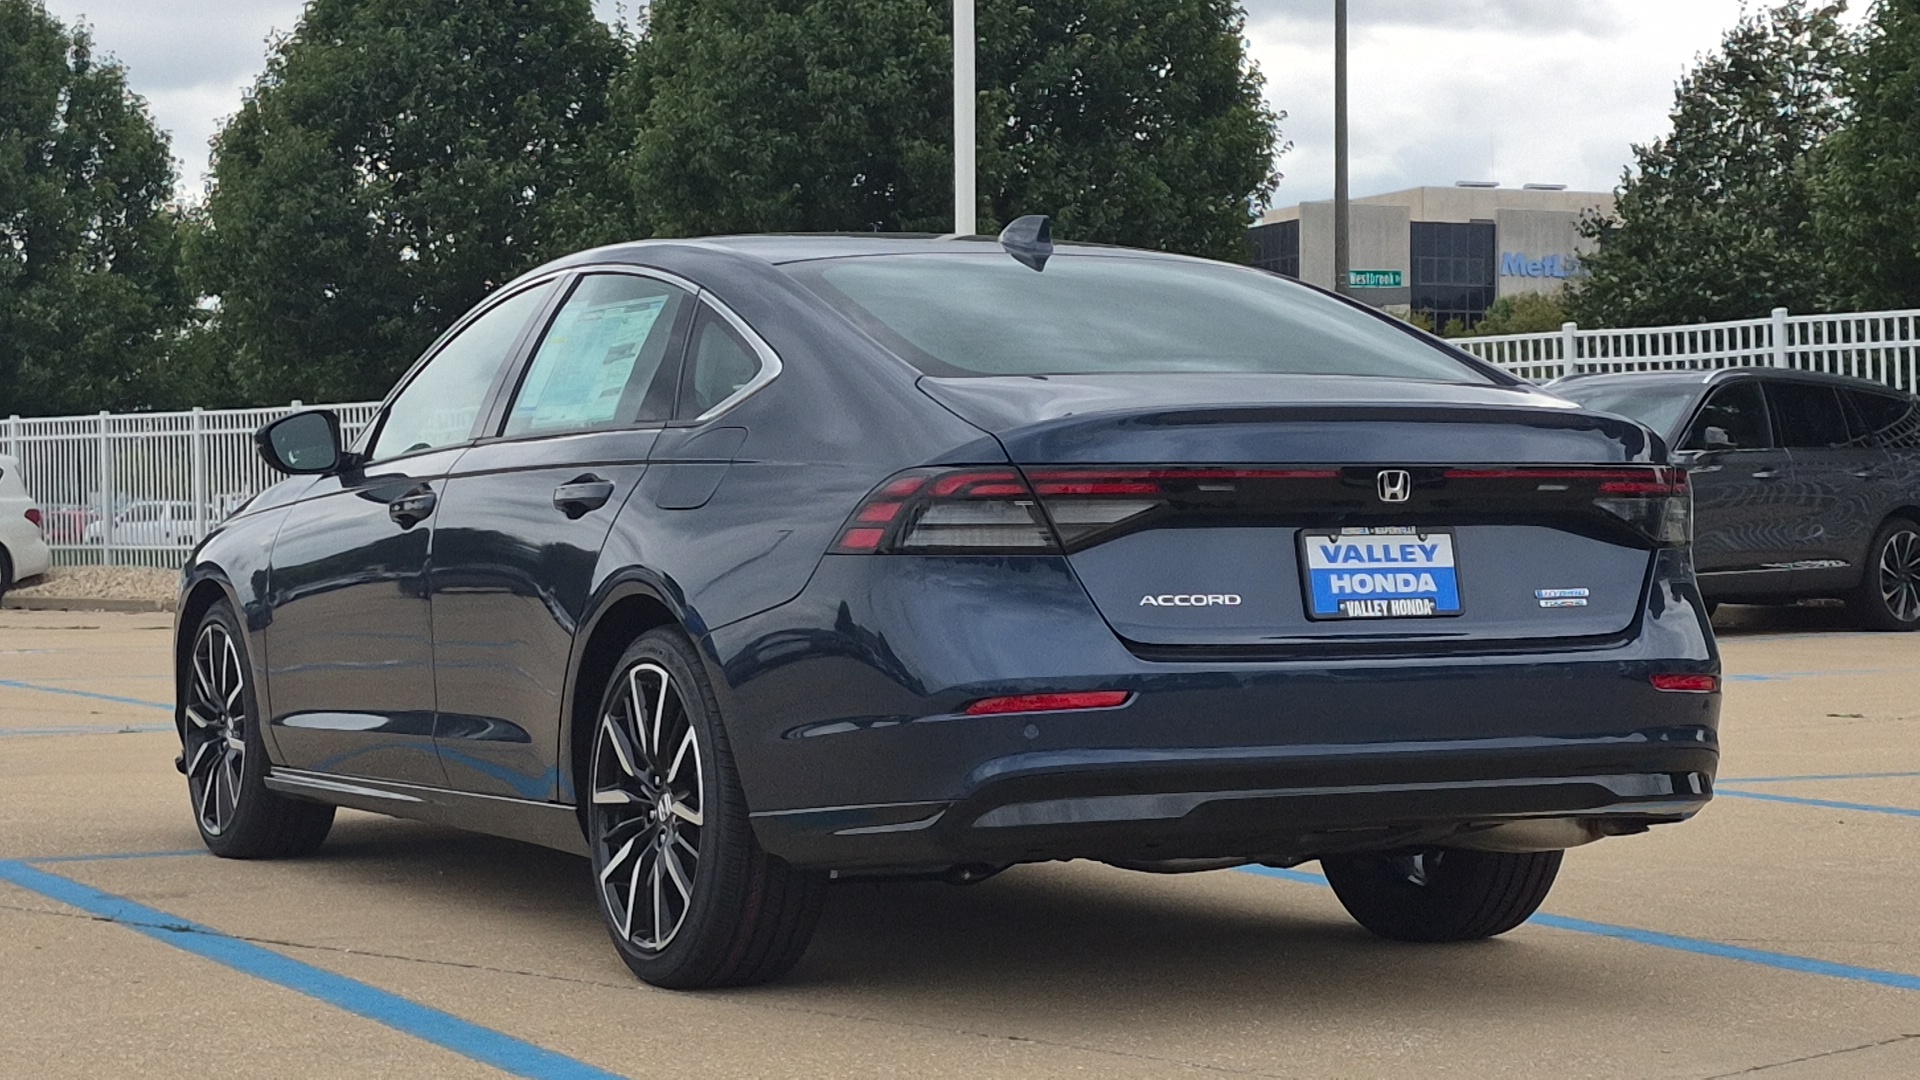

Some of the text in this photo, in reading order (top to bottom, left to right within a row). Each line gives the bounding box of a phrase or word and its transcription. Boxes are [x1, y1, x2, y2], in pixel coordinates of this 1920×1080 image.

[1502, 252, 1592, 278] MetL
[1319, 544, 1438, 564] VALLEY
[1330, 573, 1438, 594] HONDA
[1139, 594, 1242, 606] ACCORD
[1345, 599, 1432, 617] VALLEY HONDA
